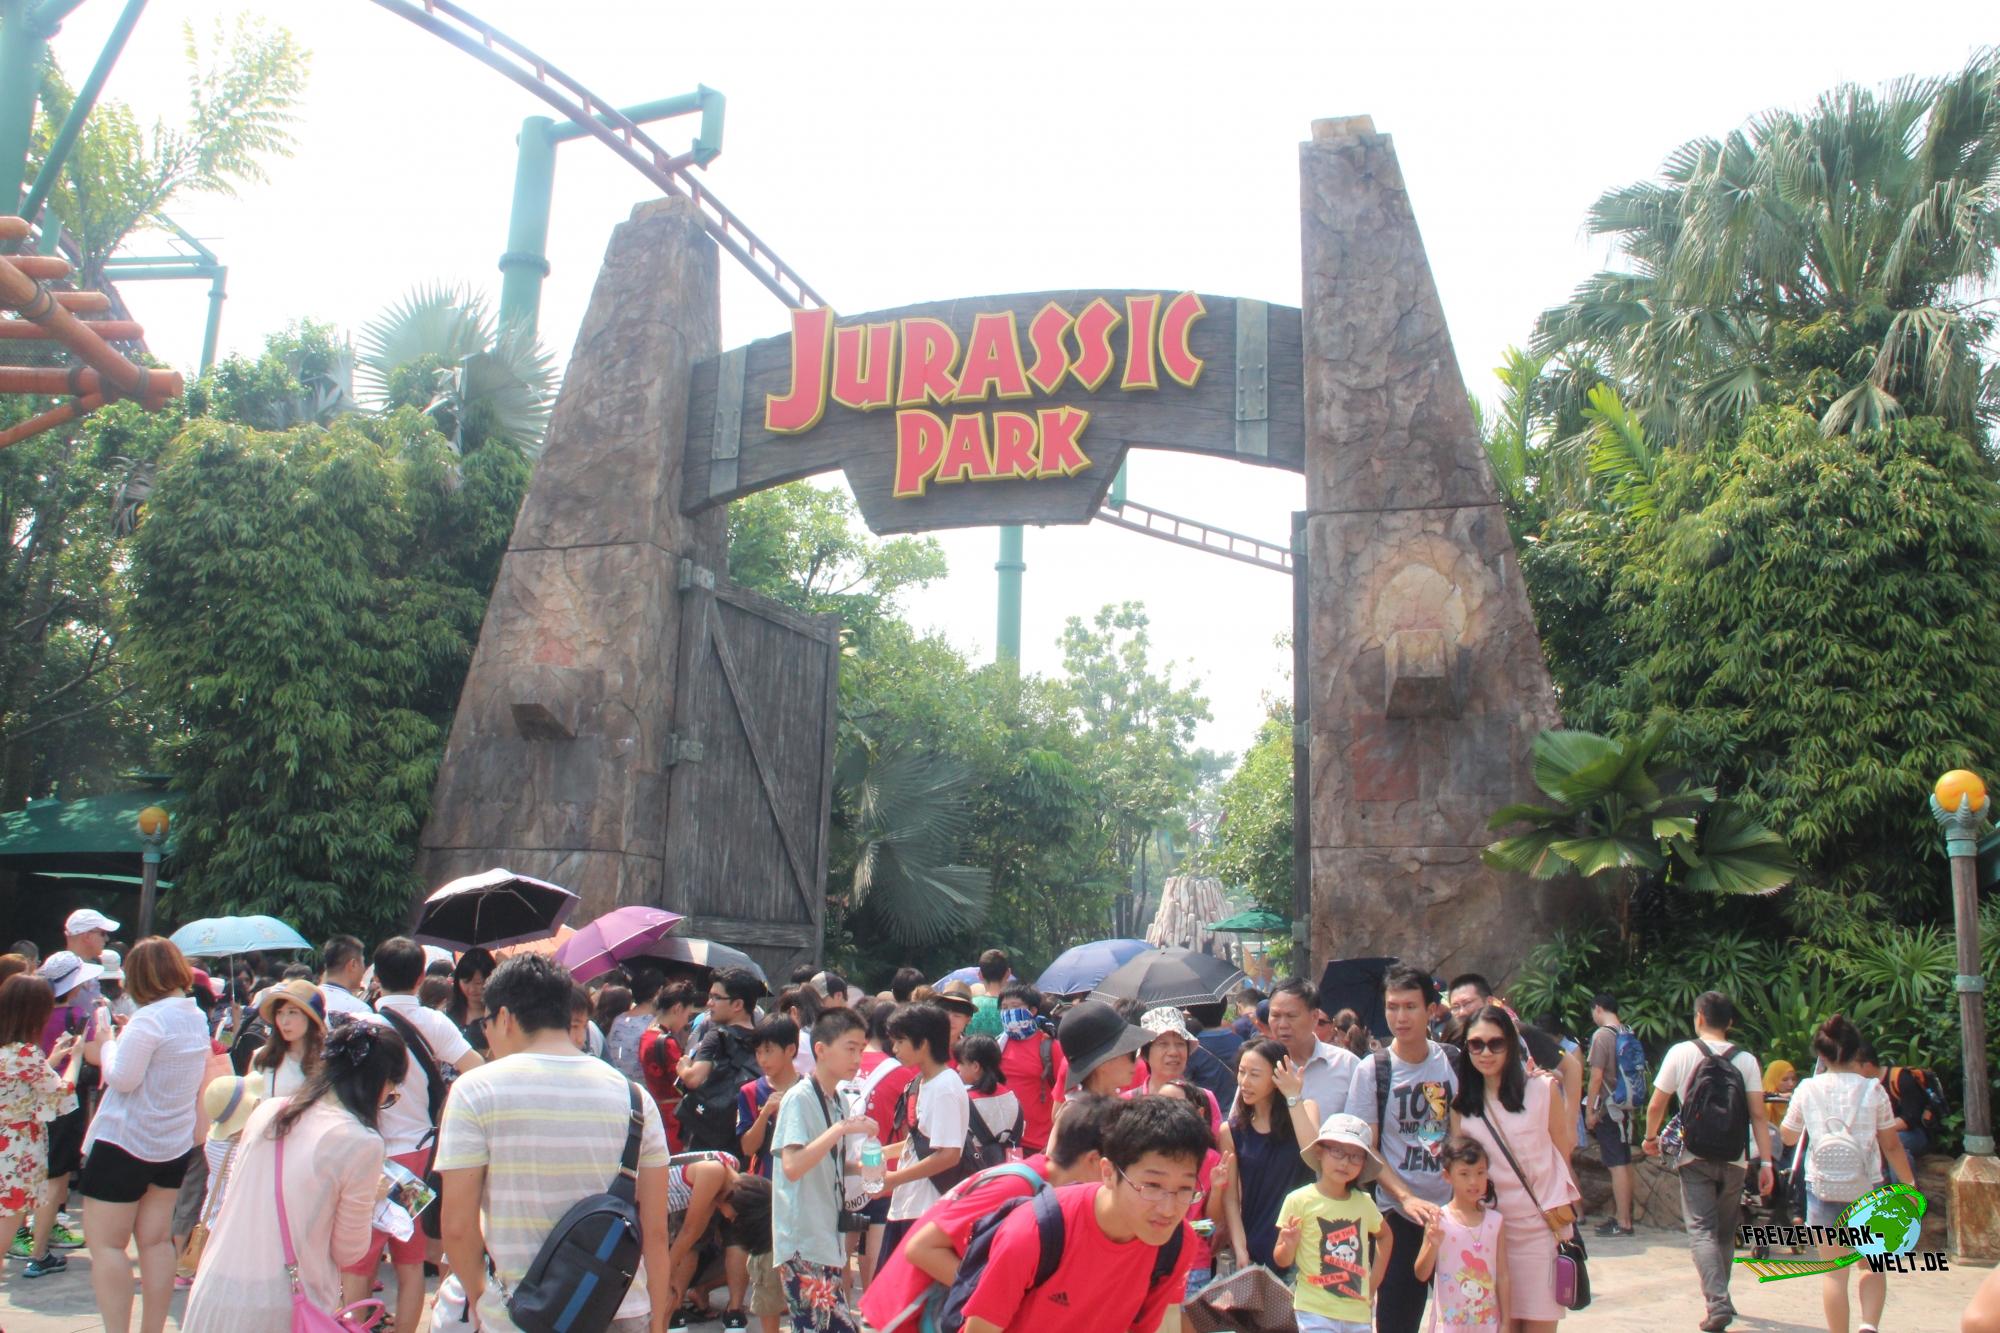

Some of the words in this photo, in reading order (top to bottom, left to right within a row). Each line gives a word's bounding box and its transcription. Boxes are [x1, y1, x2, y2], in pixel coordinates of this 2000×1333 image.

[765, 290, 1206, 432] JURASSIC
[894, 404, 1091, 497] PARK
[1399, 1121, 1419, 1134] AND
